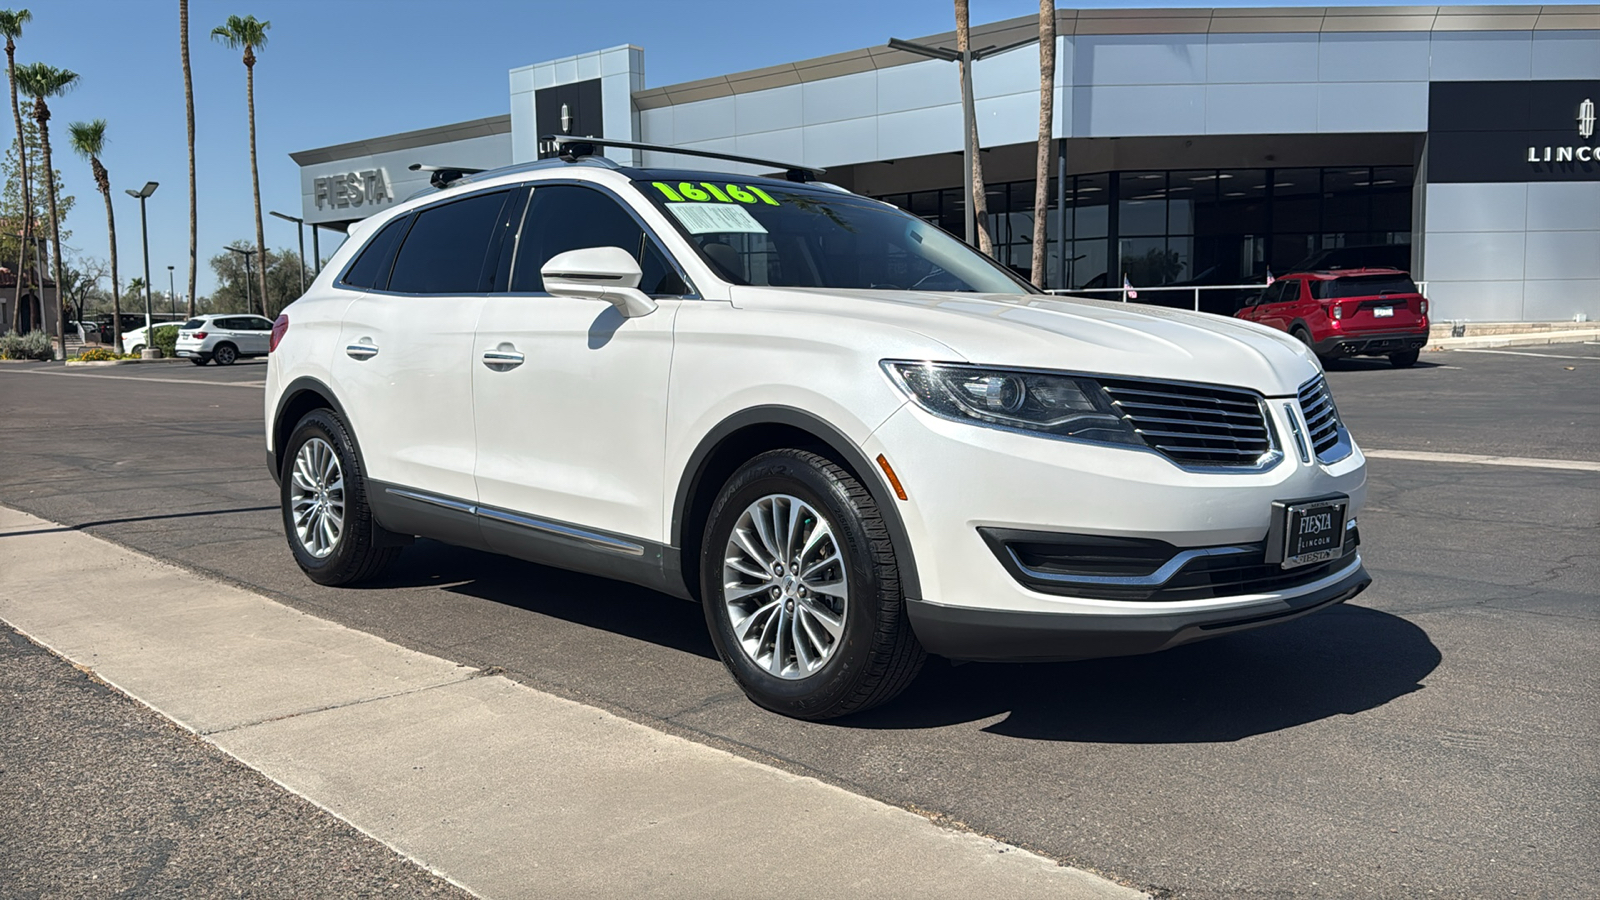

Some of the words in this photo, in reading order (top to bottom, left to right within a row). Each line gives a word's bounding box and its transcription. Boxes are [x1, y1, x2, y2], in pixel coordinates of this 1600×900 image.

[314, 168, 394, 207] FIESTA
[652, 182, 780, 206] 16161
[1299, 513, 1332, 534] FIESTA
[1302, 537, 1330, 548] LINCOLN
[1298, 551, 1331, 563] FIESTA
